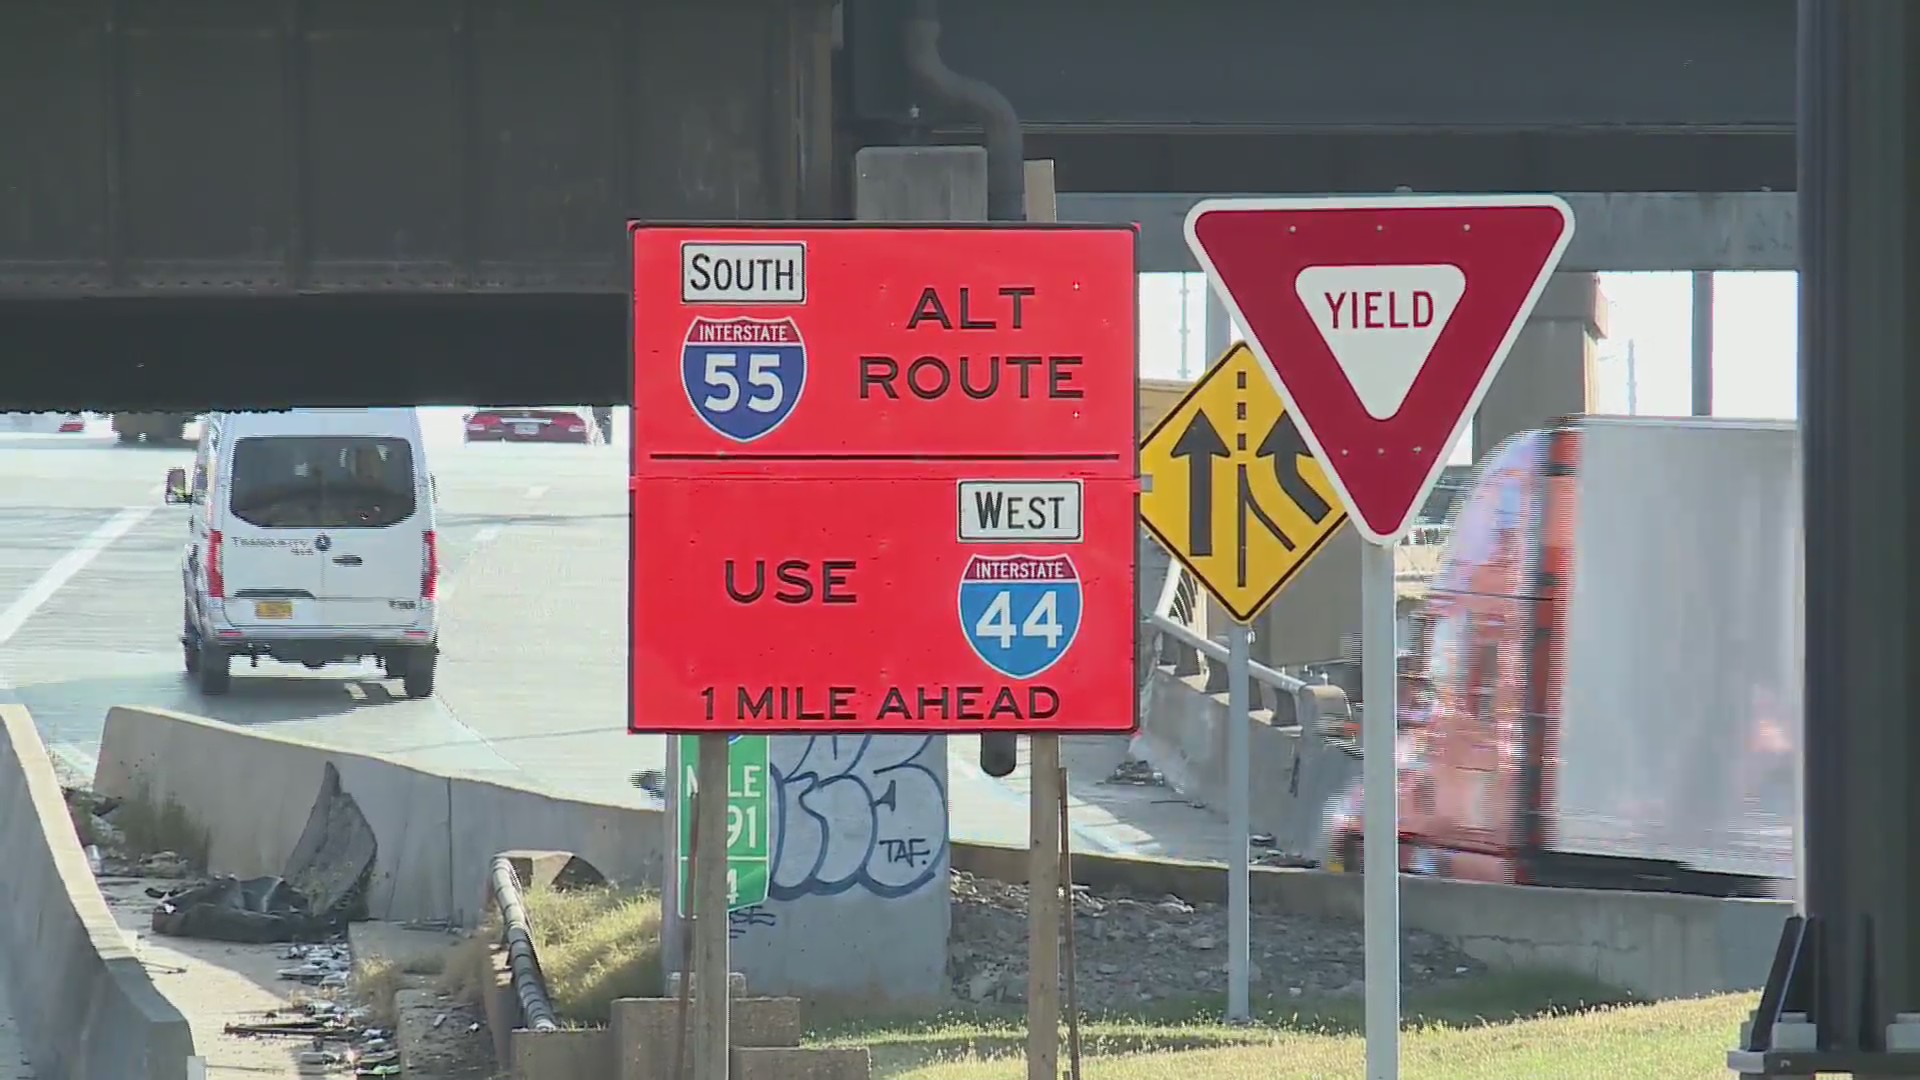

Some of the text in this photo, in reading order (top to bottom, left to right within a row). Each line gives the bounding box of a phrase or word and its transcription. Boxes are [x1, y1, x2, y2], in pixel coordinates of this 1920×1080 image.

[690, 252, 794, 291] SOUTH
[906, 287, 1036, 330] ALT
[1324, 291, 1434, 329] YIELD
[699, 324, 788, 343] INTERSTATE
[703, 353, 785, 413] 55
[860, 355, 1084, 400] ROUTE
[975, 491, 1065, 530] WEST
[725, 560, 857, 604] USE
[976, 562, 1065, 579] INTERSTATE
[975, 591, 1063, 649] 44
[701, 686, 1060, 720] 1 MILE AHEAD
[687, 765, 761, 797] MLE
